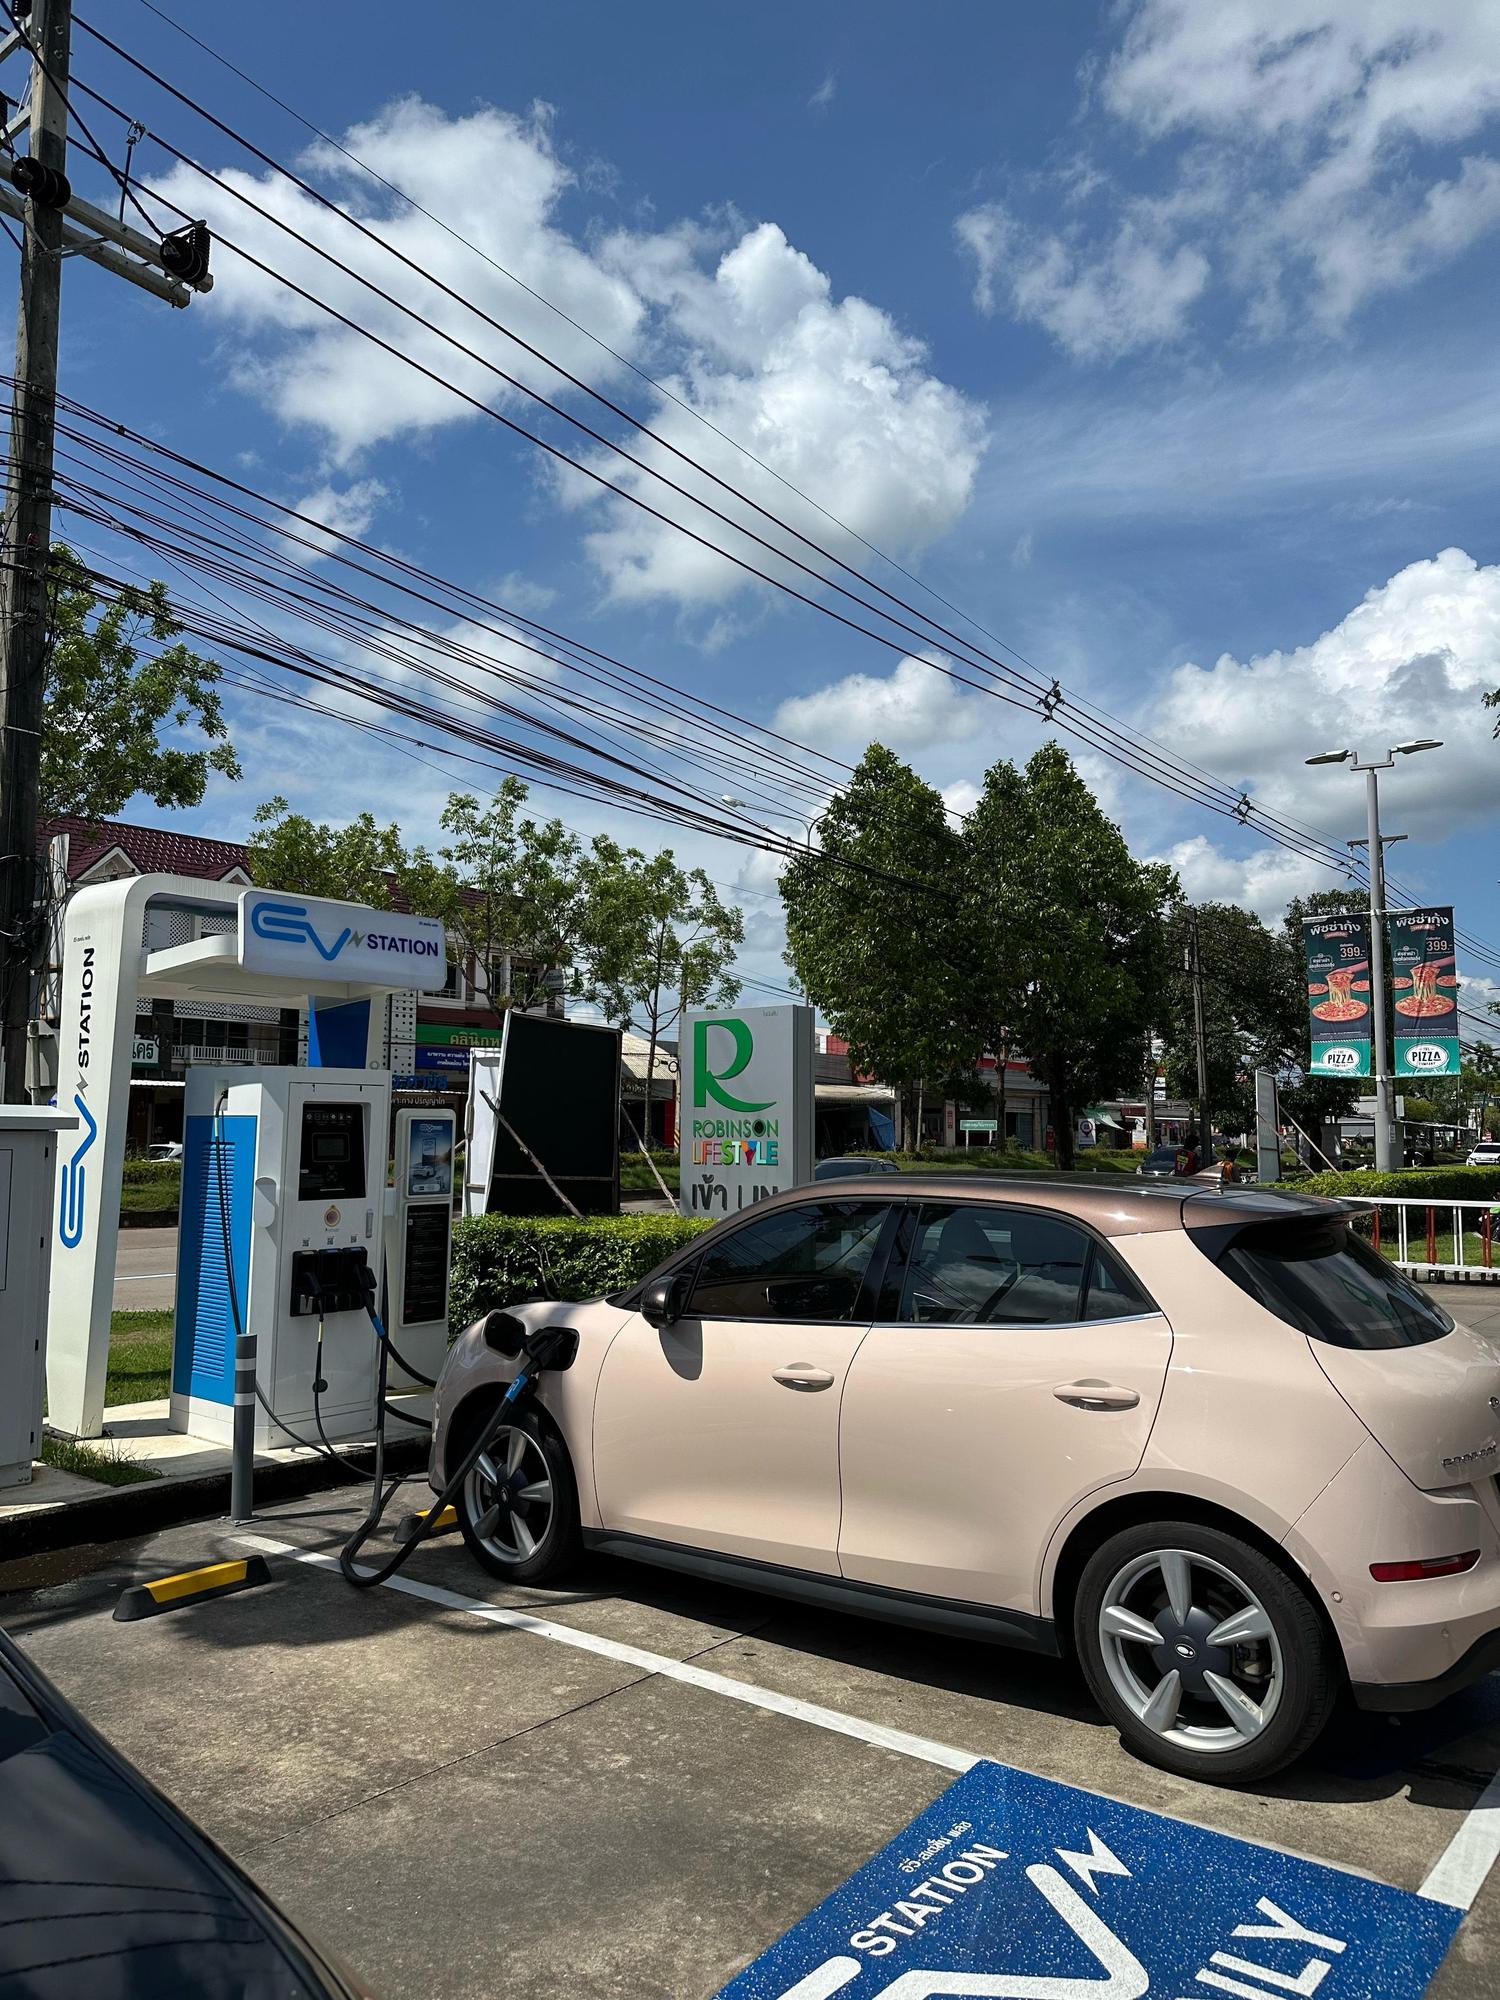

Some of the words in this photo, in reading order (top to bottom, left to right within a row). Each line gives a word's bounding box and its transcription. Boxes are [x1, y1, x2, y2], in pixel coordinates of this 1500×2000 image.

[251, 902, 352, 961] EV
[367, 934, 439, 957] STATION
[694, 1018, 777, 1113] R
[1328, 1054, 1354, 1064] PIZZA
[1412, 1051, 1441, 1062] PIZZA
[59, 1094, 97, 1249] EV
[78, 947, 95, 1068] STATION
[693, 1119, 779, 1138] ROBINSON
[691, 1140, 779, 1166] LIFESTYLE
[692, 1174, 728, 1211] เข้า
[850, 1843, 1010, 1957] STATION
